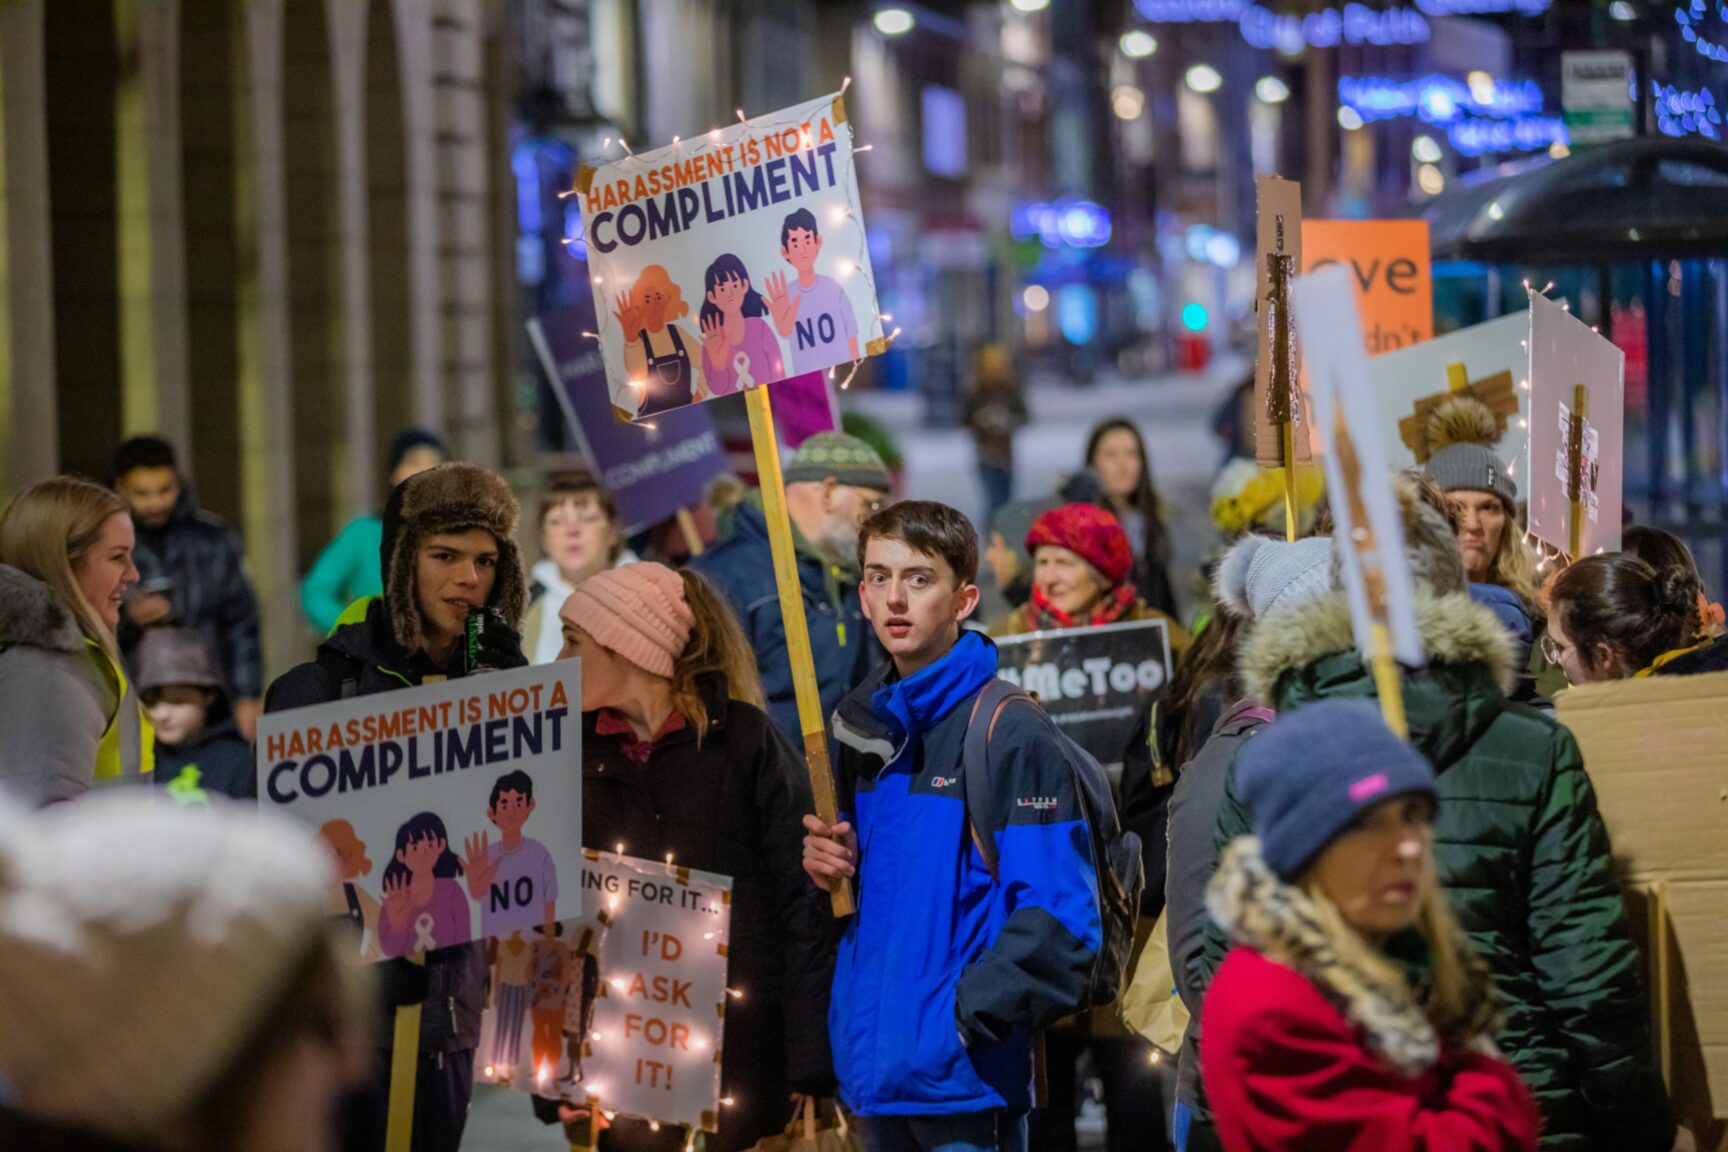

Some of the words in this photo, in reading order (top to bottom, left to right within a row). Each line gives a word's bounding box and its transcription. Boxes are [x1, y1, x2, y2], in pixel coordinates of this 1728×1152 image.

[586, 145, 735, 213] HARASSMENT
[740, 138, 761, 168] IS
[764, 122, 811, 162] NOT
[818, 117, 834, 144] A
[590, 142, 837, 253] COMPLIMENT
[795, 312, 835, 350] NO
[267, 702, 452, 762] HARASSMENT
[459, 695, 482, 723] IS
[488, 684, 544, 719] NOT
[549, 680, 568, 709] A
[267, 707, 568, 804] COMPLIMENT
[490, 876, 533, 913] NO
[581, 869, 619, 893] ING
[628, 879, 674, 905] FOR
[681, 889, 718, 914] IT...
[642, 930, 683, 961] I'D
[628, 971, 692, 1009] ASK
[624, 1013, 690, 1051] FOR
[635, 1058, 674, 1091] IT!
